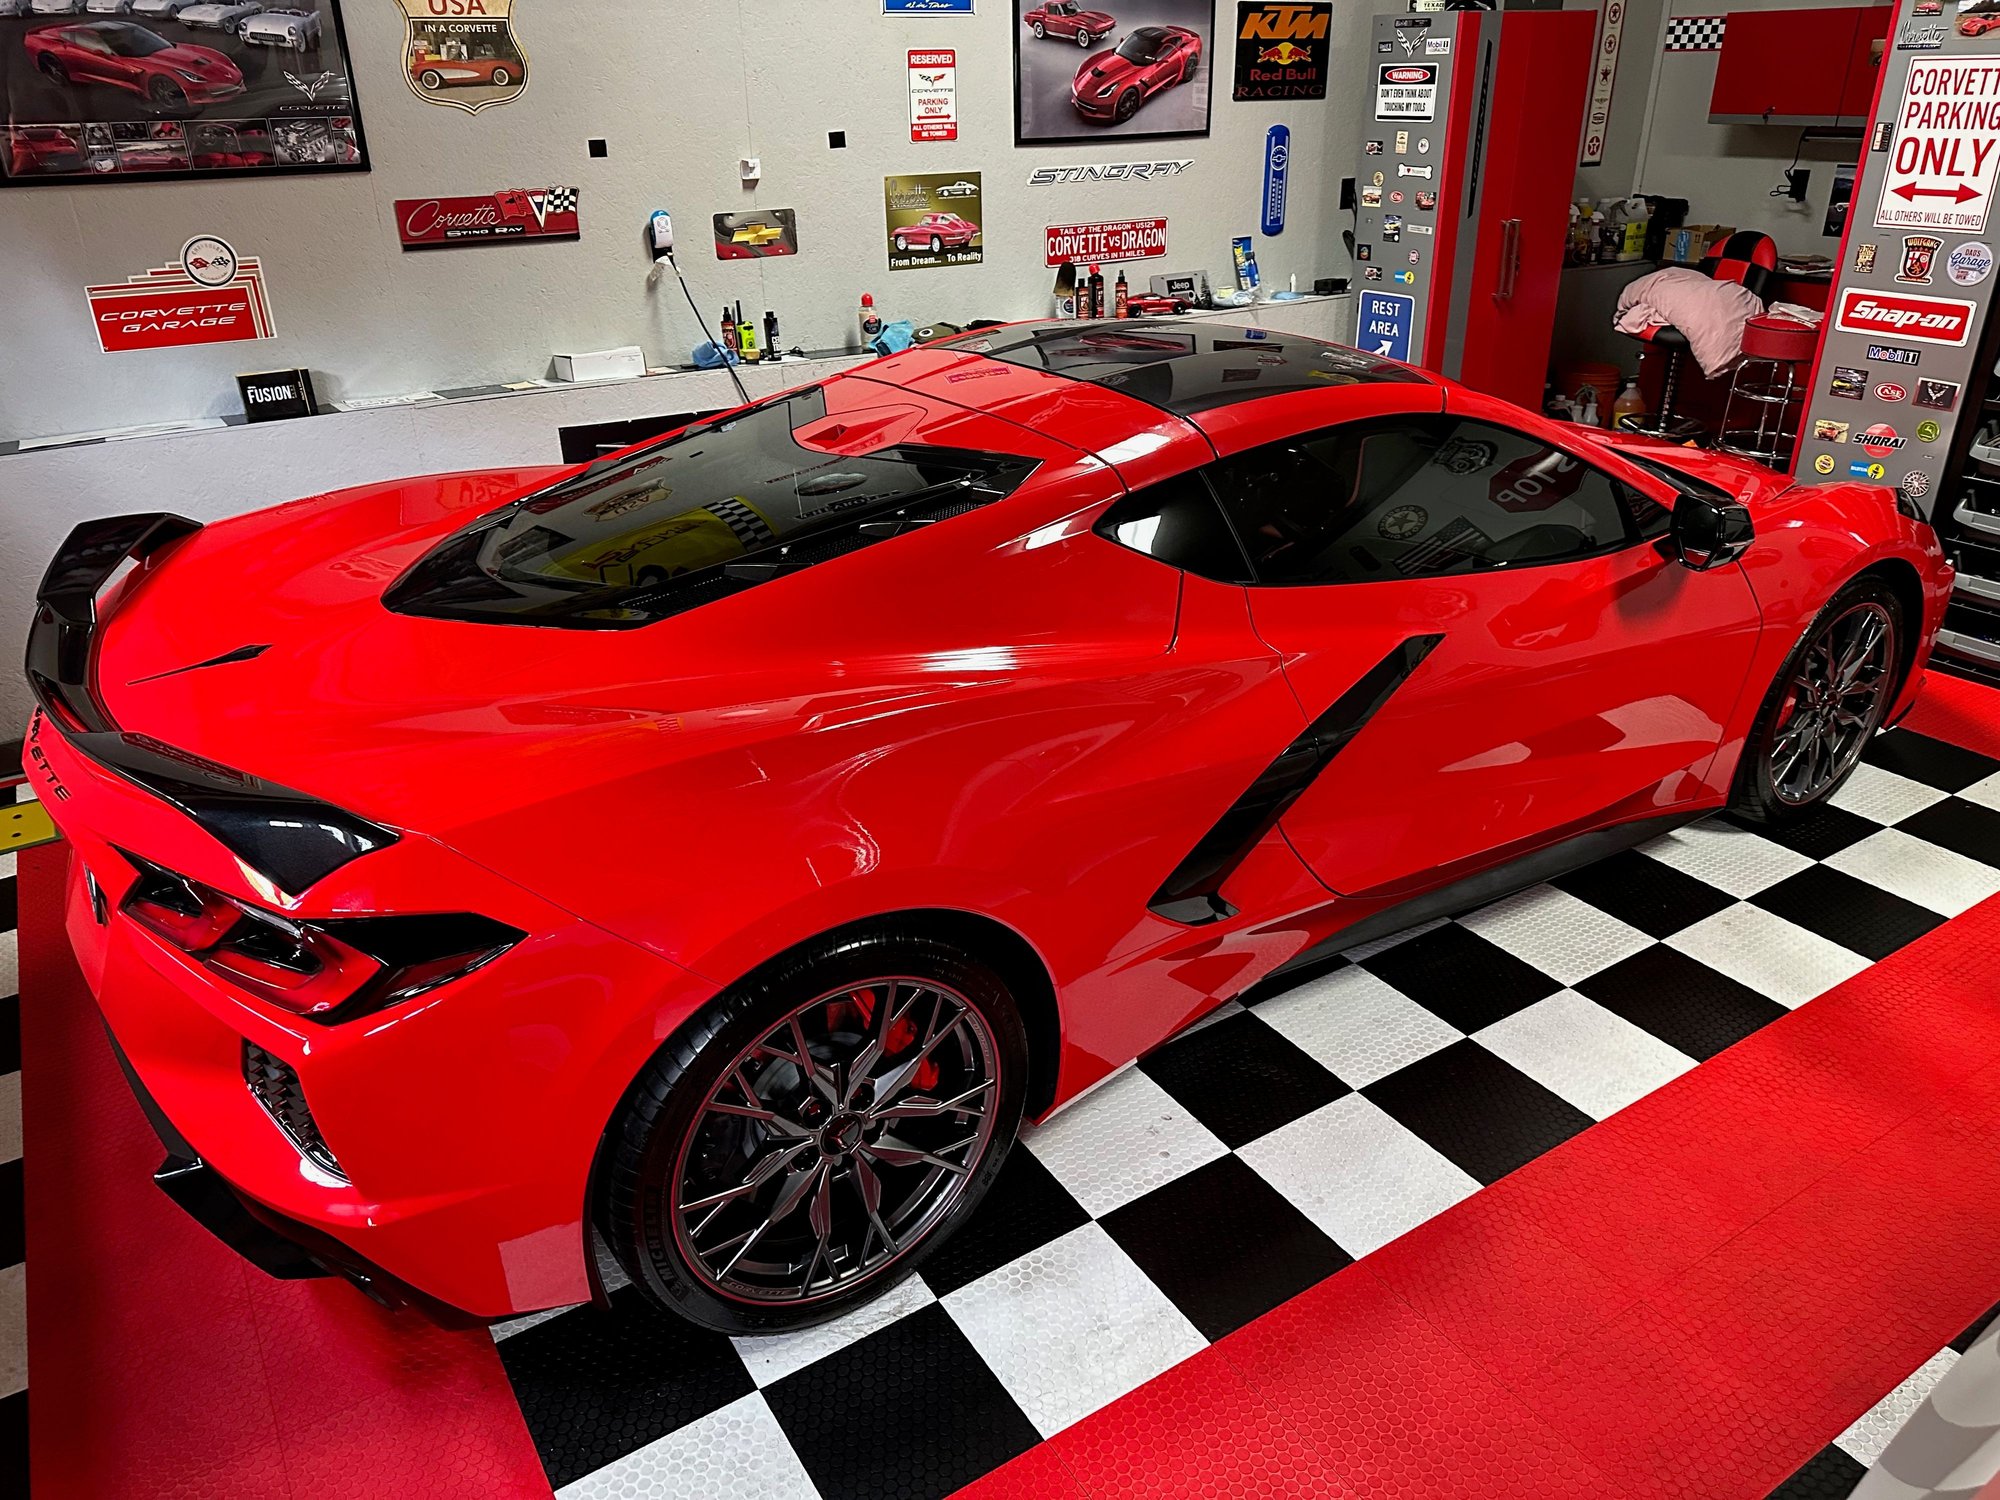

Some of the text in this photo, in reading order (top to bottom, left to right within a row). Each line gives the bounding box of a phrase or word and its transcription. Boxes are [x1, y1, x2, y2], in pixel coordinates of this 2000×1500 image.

[428, 0, 486, 15] USA
[424, 24, 498, 33] IN A CORVETTE
[1239, 5, 1330, 39] KTM
[1900, 20, 1948, 43] Corvette
[910, 54, 953, 64] RESERVED
[1250, 68, 1316, 81] Red Bull
[1392, 71, 1423, 80] WARNING
[1909, 67, 2000, 96] CORVETT
[1236, 84, 1323, 97] RACING
[1393, 89, 1404, 98] EVEN
[1405, 89, 1417, 98] THINK
[1418, 89, 1432, 98] ABOUT
[1384, 102, 1426, 112] TOUCHING MY TOOLS
[1904, 102, 2000, 130] PARKING
[1895, 137, 1996, 177] ONLY
[1029, 160, 1194, 185] STINGRAY
[406, 201, 501, 237] Corvette
[1879, 210, 1982, 226] ALL OTHERS WILL BE TOWED
[446, 227, 523, 237] STING RAY
[1059, 221, 1156, 235] TAIL OF THE DRAGON US129
[1047, 227, 1166, 257] CORVETTE VS DRAGON
[1907, 237, 1939, 249] WOLFGANG
[890, 258, 910, 267] From
[946, 253, 956, 262] To
[957, 252, 982, 262] Reality
[1082, 253, 1110, 262] CURVES
[1126, 250, 1146, 258] MILES
[1950, 252, 1991, 269] Garage
[1171, 281, 1190, 290] Jeep
[100, 302, 247, 322] CORVETTE
[1371, 300, 1401, 317] REST
[1848, 300, 1962, 330] Snap-on
[122, 316, 236, 333] GARAGE
[1369, 320, 1399, 337] AREA
[1868, 346, 1904, 362] Mobil
[247, 384, 292, 404] FUSION
[1852, 433, 1907, 449] SHORAI
